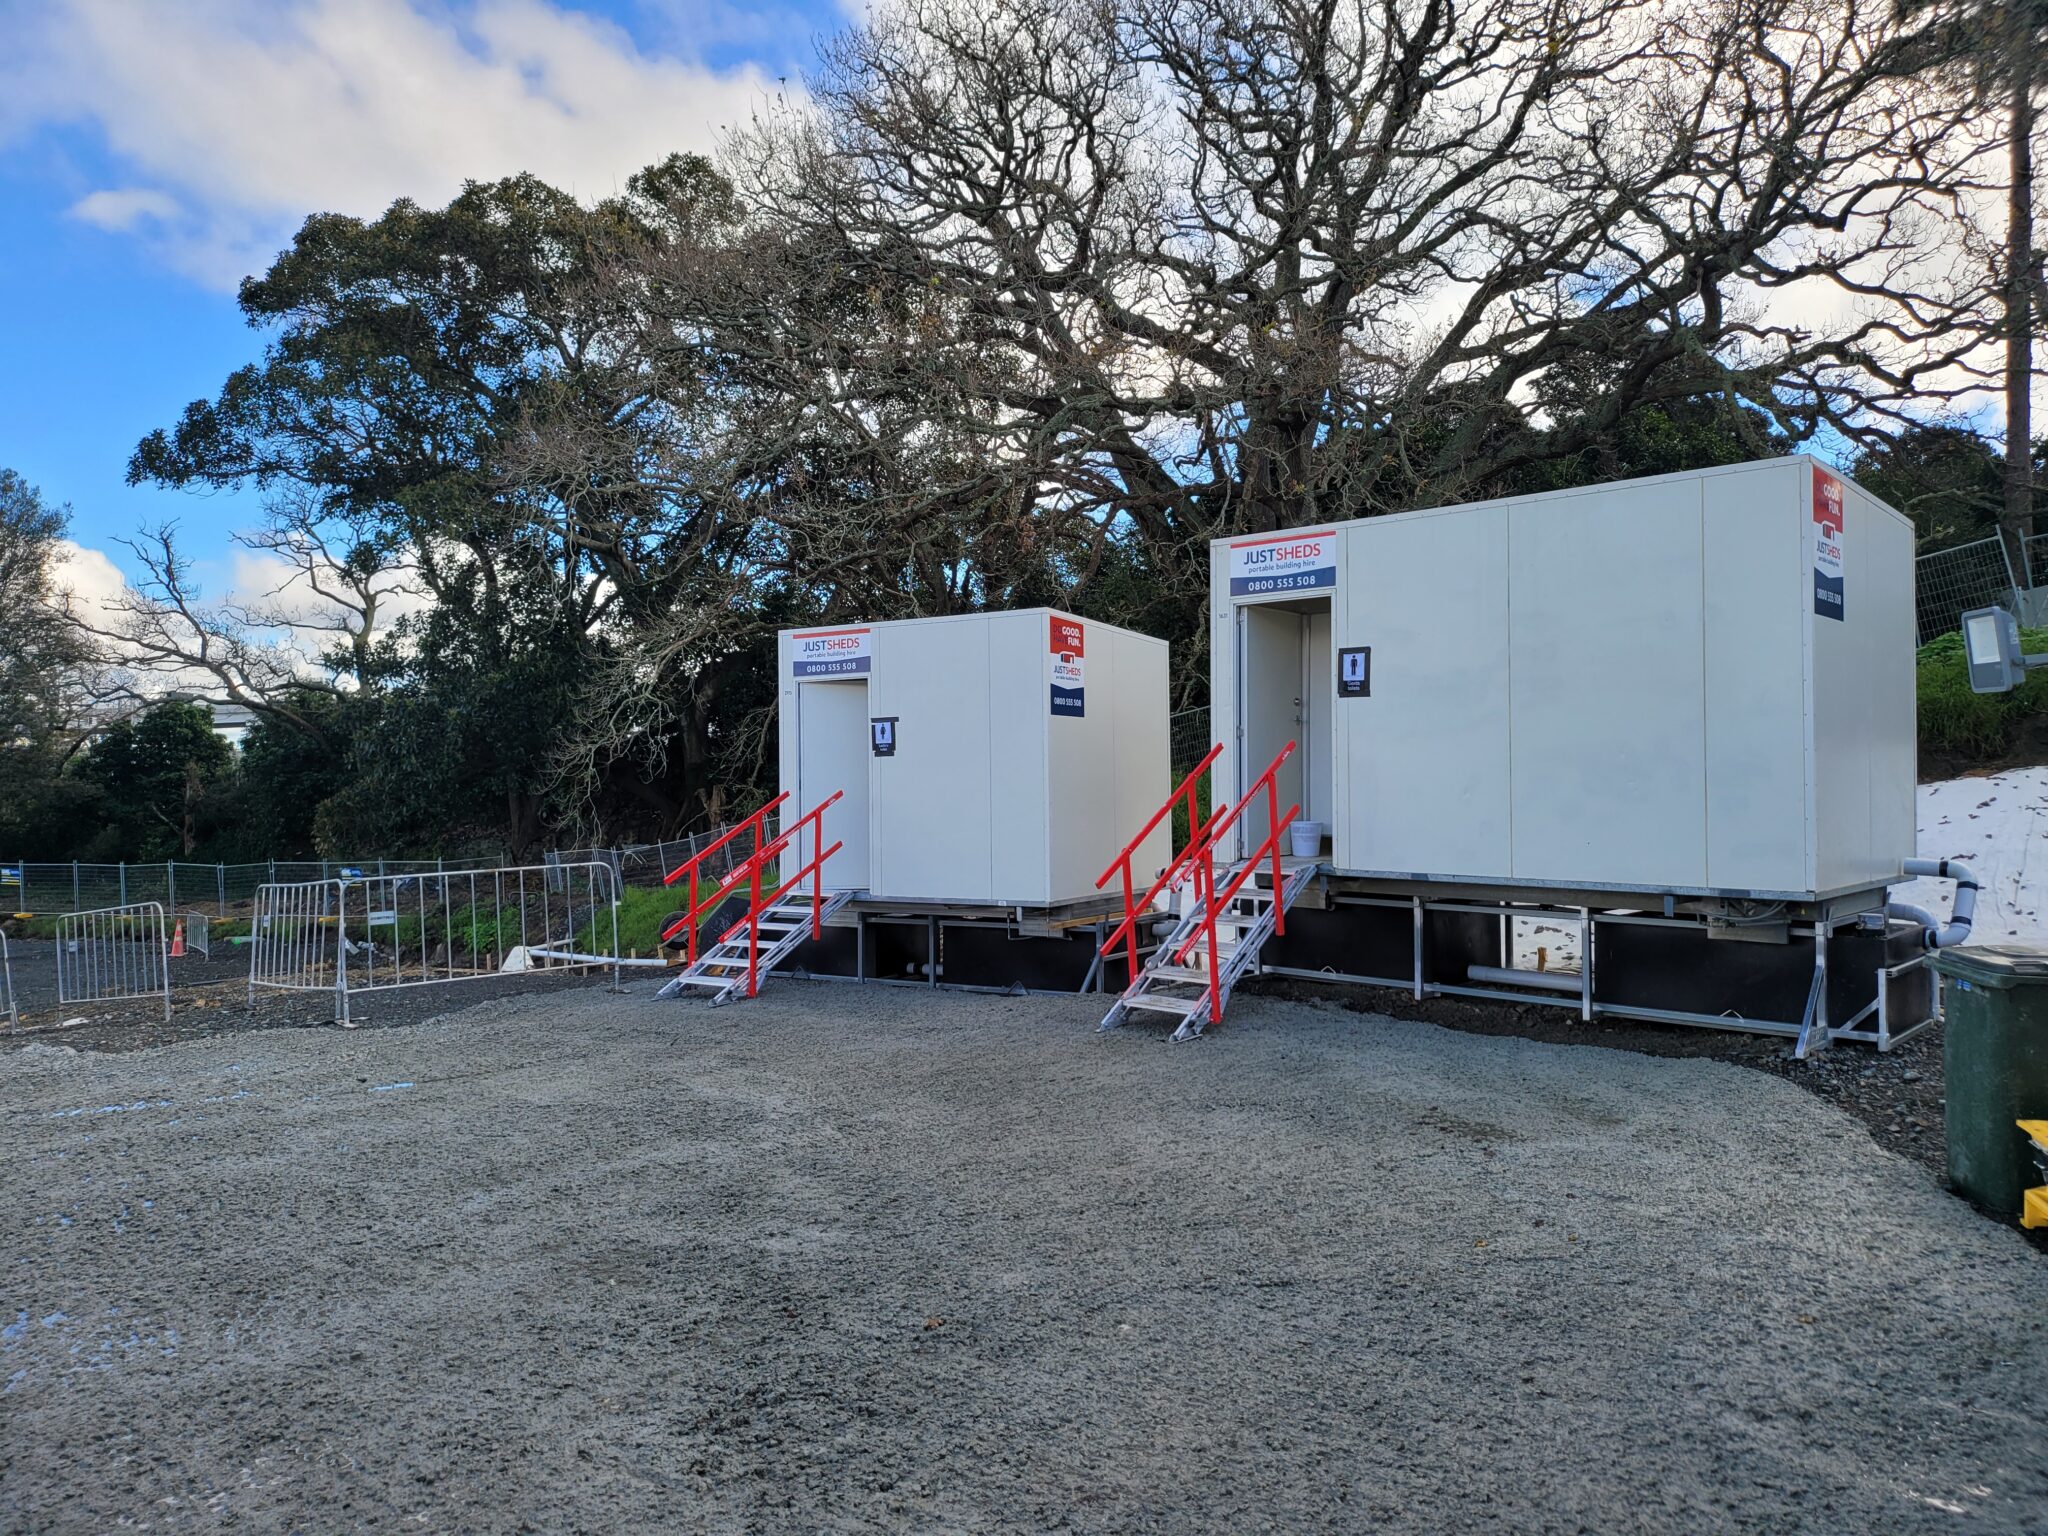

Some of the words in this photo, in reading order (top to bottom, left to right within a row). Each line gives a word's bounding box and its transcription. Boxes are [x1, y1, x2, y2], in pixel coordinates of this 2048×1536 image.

[1244, 543, 1321, 565] JUSTSHEDS
[1817, 540, 1841, 560] JUSTSHEDS
[1248, 564, 1275, 574] portable
[1276, 560, 1302, 571] building
[1303, 559, 1316, 567] hire
[1248, 580, 1274, 591] 0800
[1277, 578, 1294, 588] 555
[1297, 575, 1316, 586] 508
[1061, 626, 1081, 637] GOOD.
[803, 638, 860, 652] JUSTSHEDS
[1067, 637, 1081, 647] FUN.
[806, 651, 826, 659] portable
[806, 665, 826, 673] 0800
[828, 663, 841, 671] 555
[842, 662, 857, 670] 508
[1054, 665, 1081, 677] JUSTSHEDS
[1053, 697, 1065, 706] 0800
[1065, 698, 1074, 706] 555
[1073, 699, 1082, 707] 508
